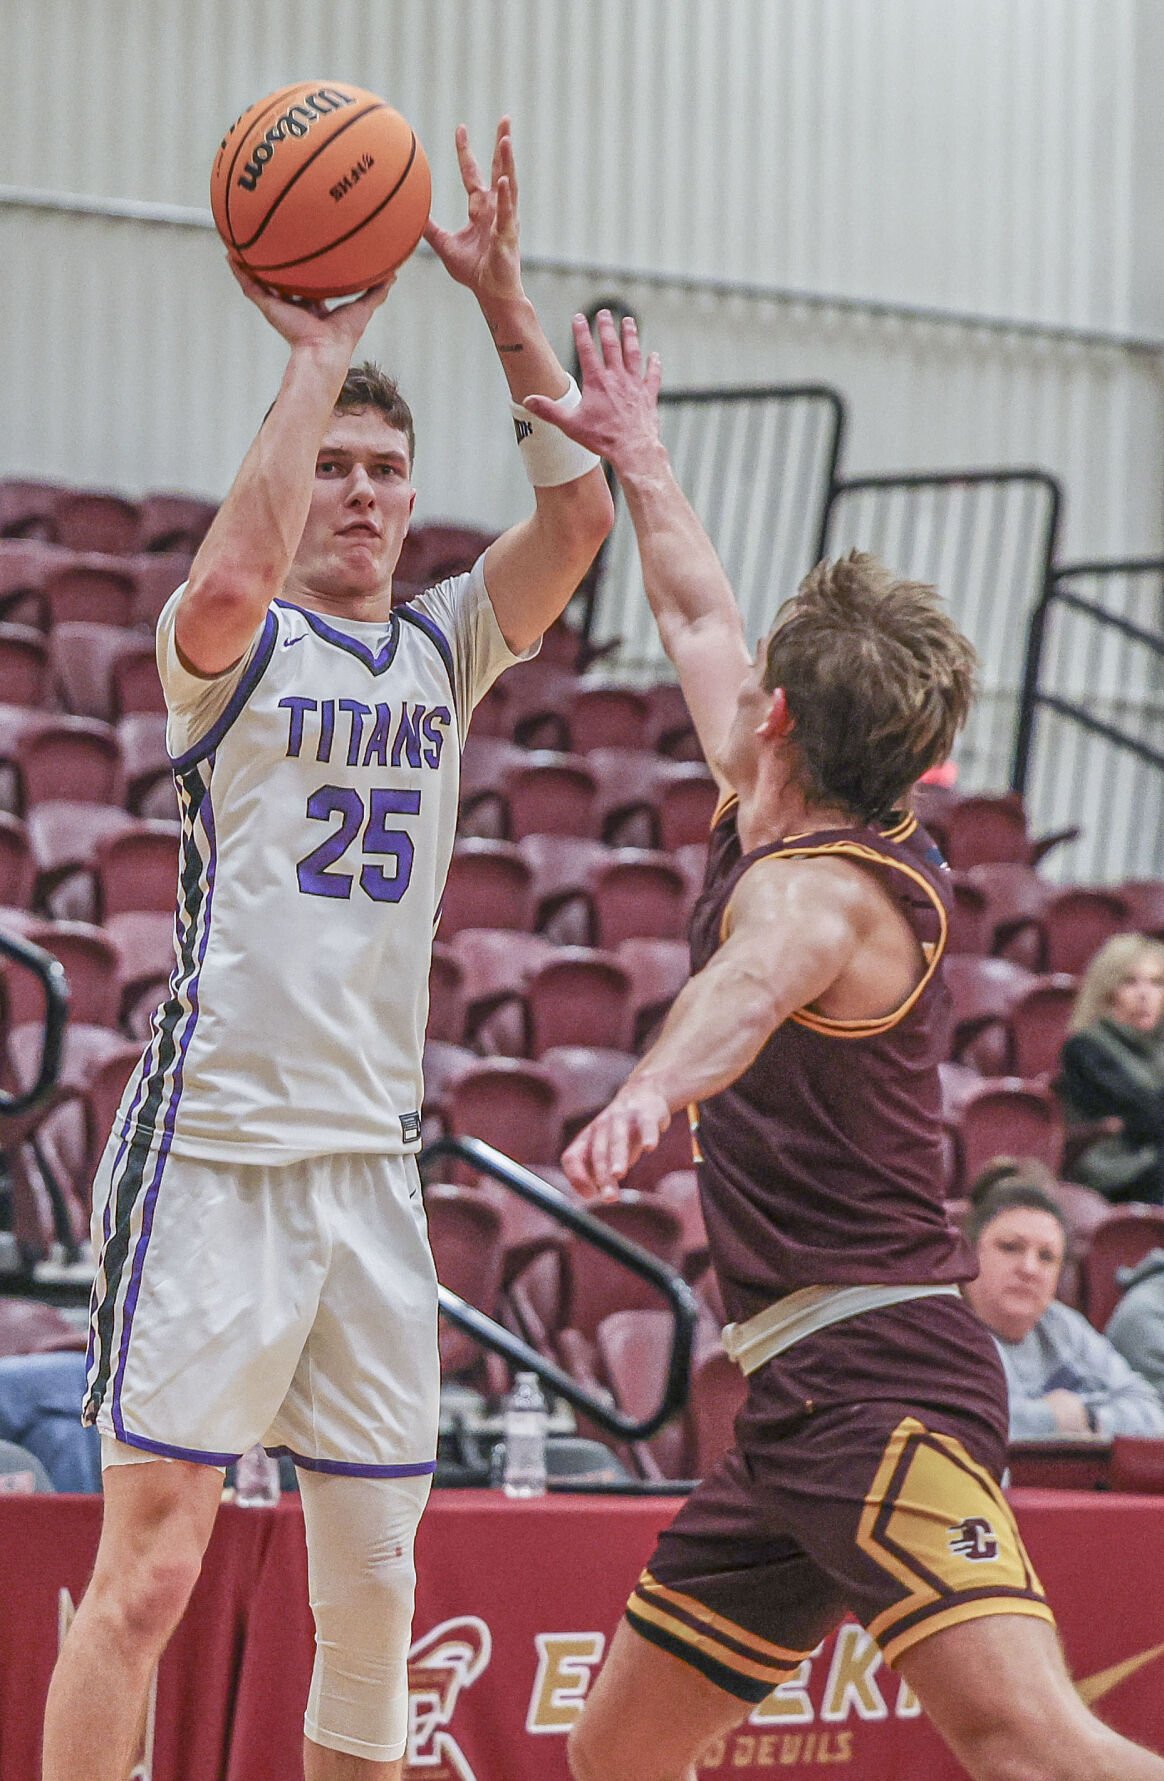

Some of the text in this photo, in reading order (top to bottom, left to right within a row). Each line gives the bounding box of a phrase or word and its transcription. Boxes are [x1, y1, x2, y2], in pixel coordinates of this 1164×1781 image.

[237, 88, 357, 192] Wilson
[278, 696, 451, 770] TITANS
[296, 784, 422, 904] 25
[733, 1731, 854, 1768] DEVILS
